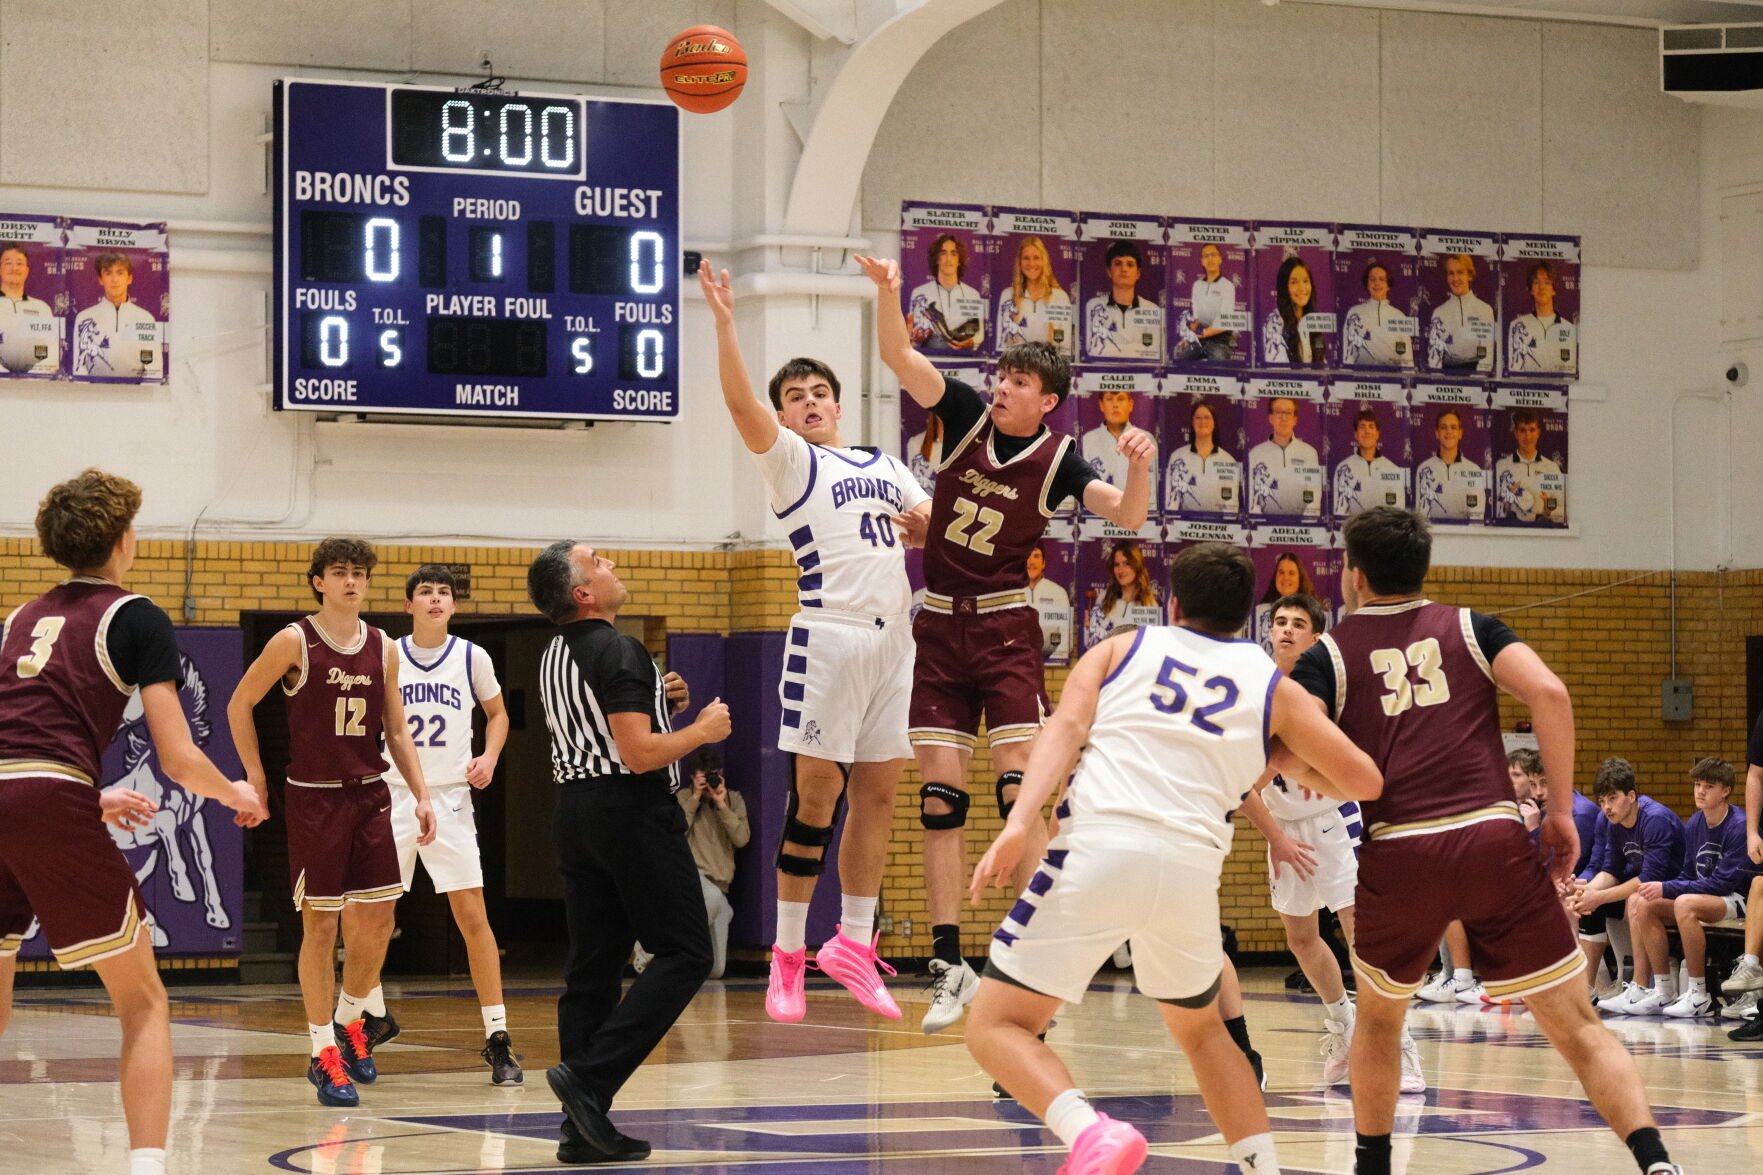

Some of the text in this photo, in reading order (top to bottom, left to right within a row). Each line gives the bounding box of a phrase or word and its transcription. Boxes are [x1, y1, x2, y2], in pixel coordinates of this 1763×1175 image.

[457, 87, 516, 97] DAKTRONICS
[441, 100, 575, 168] 8:00
[295, 170, 411, 206] BRONCS
[453, 197, 521, 221] PERIOD
[575, 185, 663, 219] GUEST
[912, 217, 980, 229] HUMBRACHT
[926, 209, 966, 219] SLATER
[1014, 215, 1057, 225] REAGAN
[1108, 221, 1138, 230] JOHN
[1109, 229, 1137, 238] HALE
[1188, 225, 1230, 234] HUNTER
[1193, 233, 1226, 243] CAZER
[1437, 236, 1482, 246] STEPHEN
[97, 238, 136, 247] BRYAN
[365, 217, 400, 282] 0
[1349, 239, 1406, 250] THOMPSON
[1518, 249, 1564, 258] MCNEESE
[491, 234, 502, 277] 1
[629, 231, 664, 294] 0
[294, 288, 358, 311] FOULS
[426, 293, 553, 320] PLAYER FOUL
[372, 308, 410, 326] T.O.L.
[564, 315, 601, 333] T.O.L.
[614, 302, 673, 325] FOULS
[320, 316, 349, 367] 0
[636, 328, 664, 378] 0
[1099, 382, 1136, 391] DOSCH
[1101, 374, 1135, 382] CALEB
[1186, 376, 1218, 385] EMMA
[1265, 380, 1303, 389] JUSTUS
[1354, 383, 1382, 391] JOSH
[294, 378, 358, 402] SCORE
[455, 384, 519, 407] MATCH
[612, 389, 673, 412] SCORE
[1258, 388, 1312, 398] MARSHALL
[1435, 386, 1464, 394] ODEN
[831, 477, 903, 512] BRONCS
[958, 468, 1019, 501] Diggers
[859, 511, 896, 548] 40
[944, 496, 1005, 557] 22
[1103, 528, 1139, 537] OLSON
[1179, 531, 1234, 541] MCLENNAN
[1187, 523, 1228, 532] JOSEPH
[1271, 527, 1311, 535] ADELAE
[16, 616, 66, 679] 3
[326, 667, 373, 692] Diggers
[1369, 637, 1450, 717] 33
[399, 682, 462, 711] RONCS
[1149, 655, 1240, 737] 52
[334, 697, 367, 737] 12
[407, 714, 447, 748] 22
